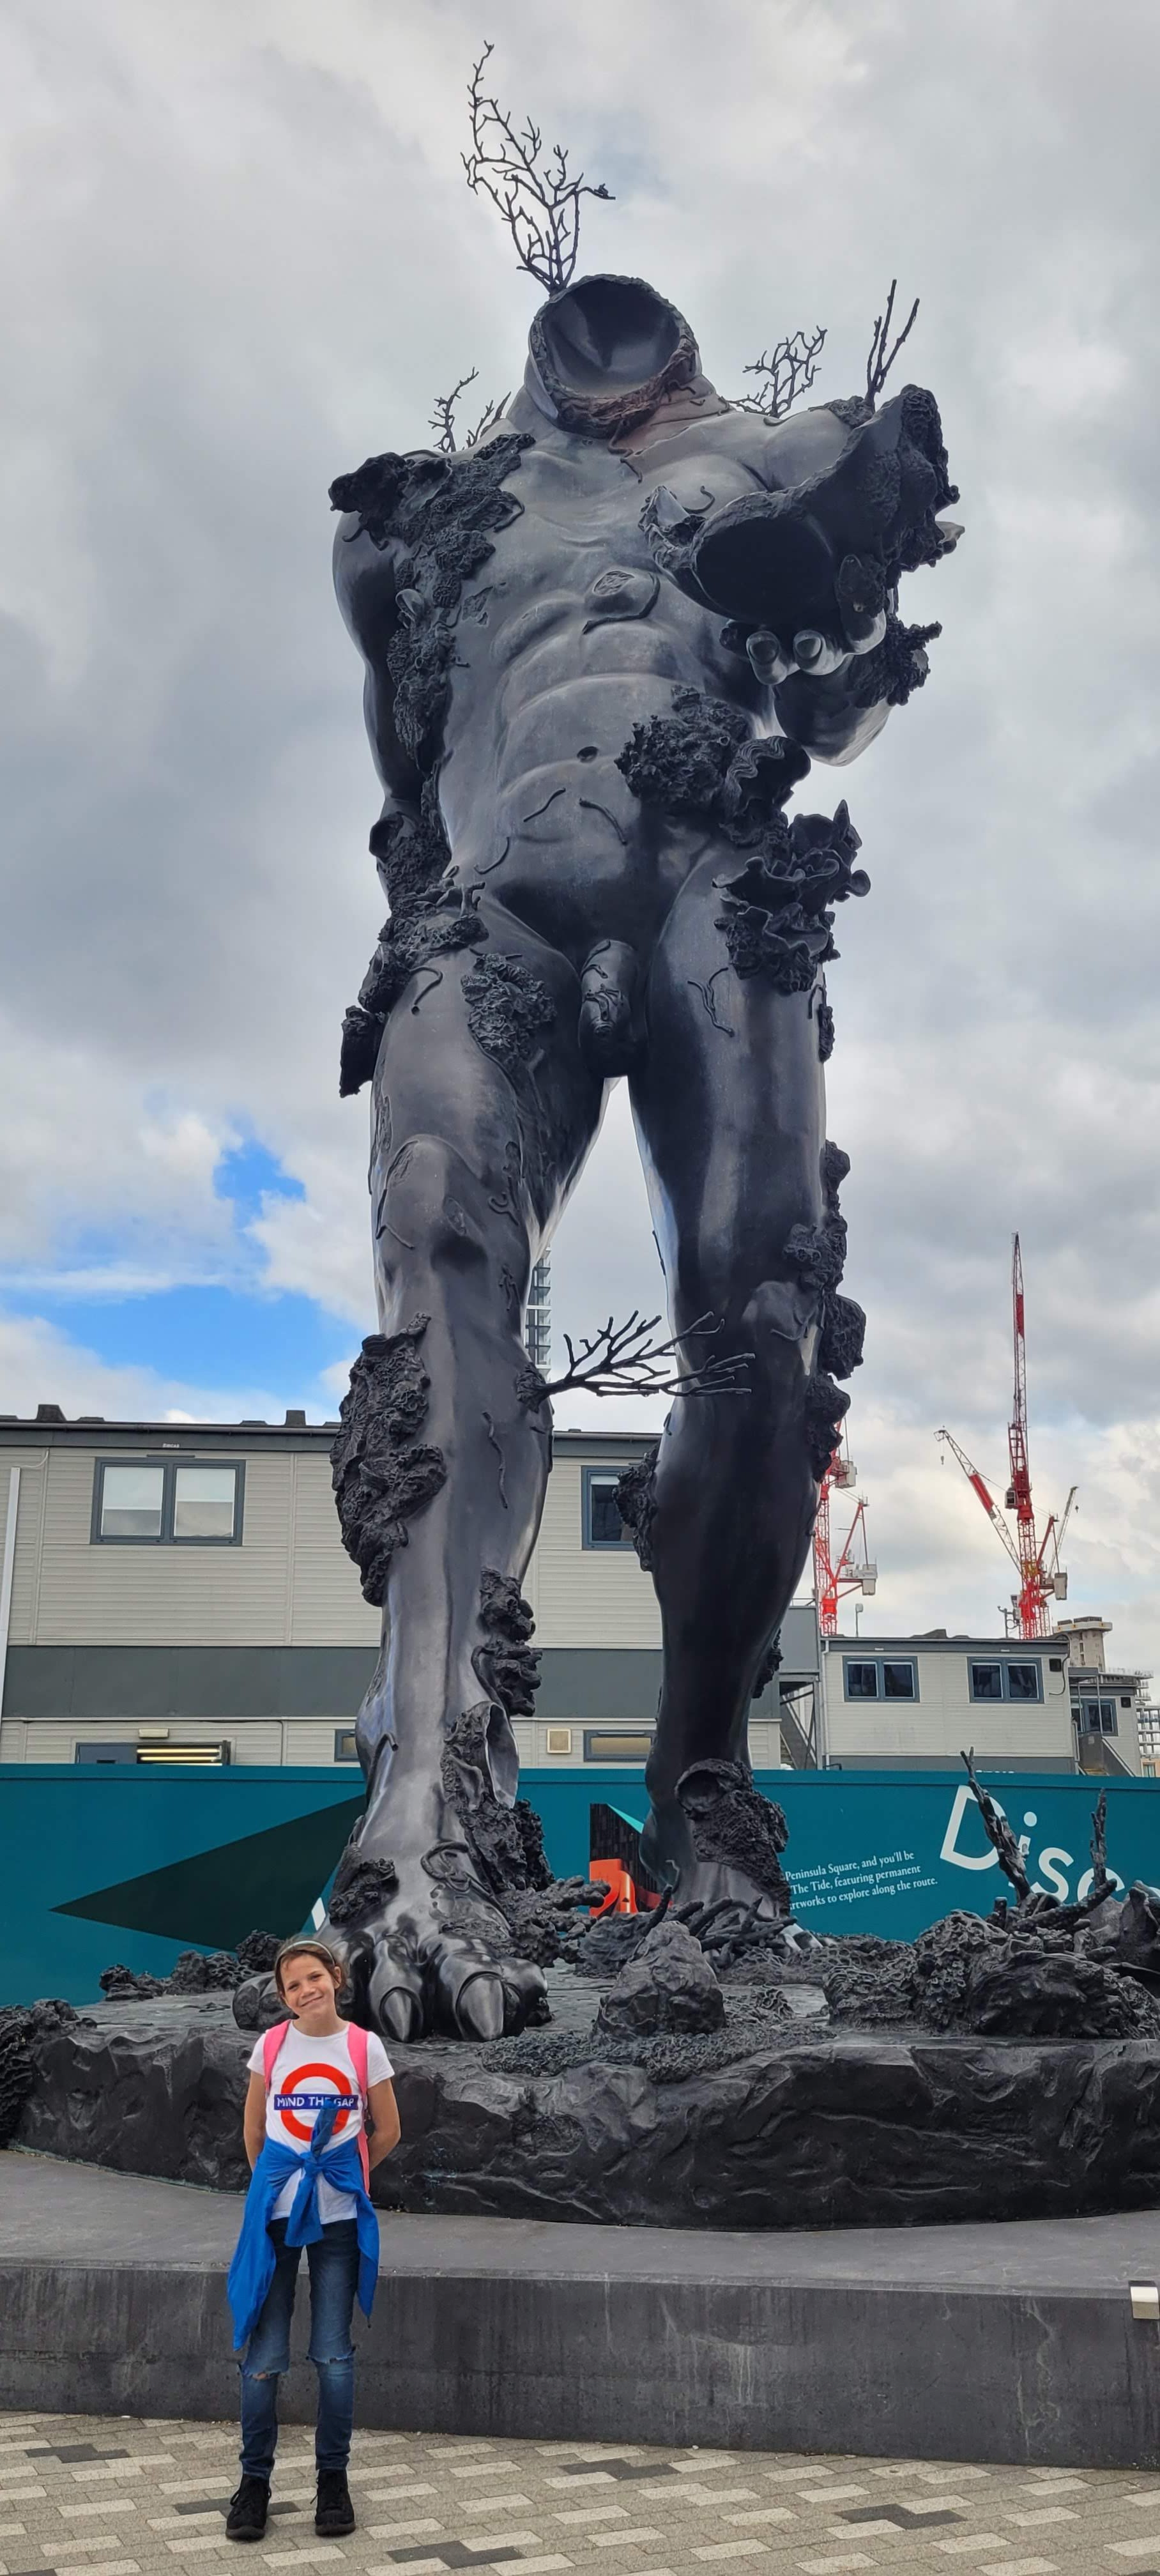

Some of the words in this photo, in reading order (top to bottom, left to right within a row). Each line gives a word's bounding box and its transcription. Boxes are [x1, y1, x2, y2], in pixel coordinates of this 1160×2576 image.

[785, 1865, 827, 1882] Peninsula
[828, 1863, 860, 1875] Square,
[861, 1855, 877, 1867] and
[879, 1851, 903, 1868] you'll
[903, 1850, 915, 1860] be
[790, 1883, 809, 1895] The
[810, 1879, 833, 1891] Tide,
[834, 1873, 874, 1884] featuring
[875, 1866, 921, 1883] permanent
[839, 1888, 870, 1903] explore
[872, 1884, 896, 1895] along
[897, 1880, 911, 1891] the
[913, 1878, 938, 1889] route.
[277, 2097, 305, 2107] MIND
[333, 2097, 355, 2107] GAP
